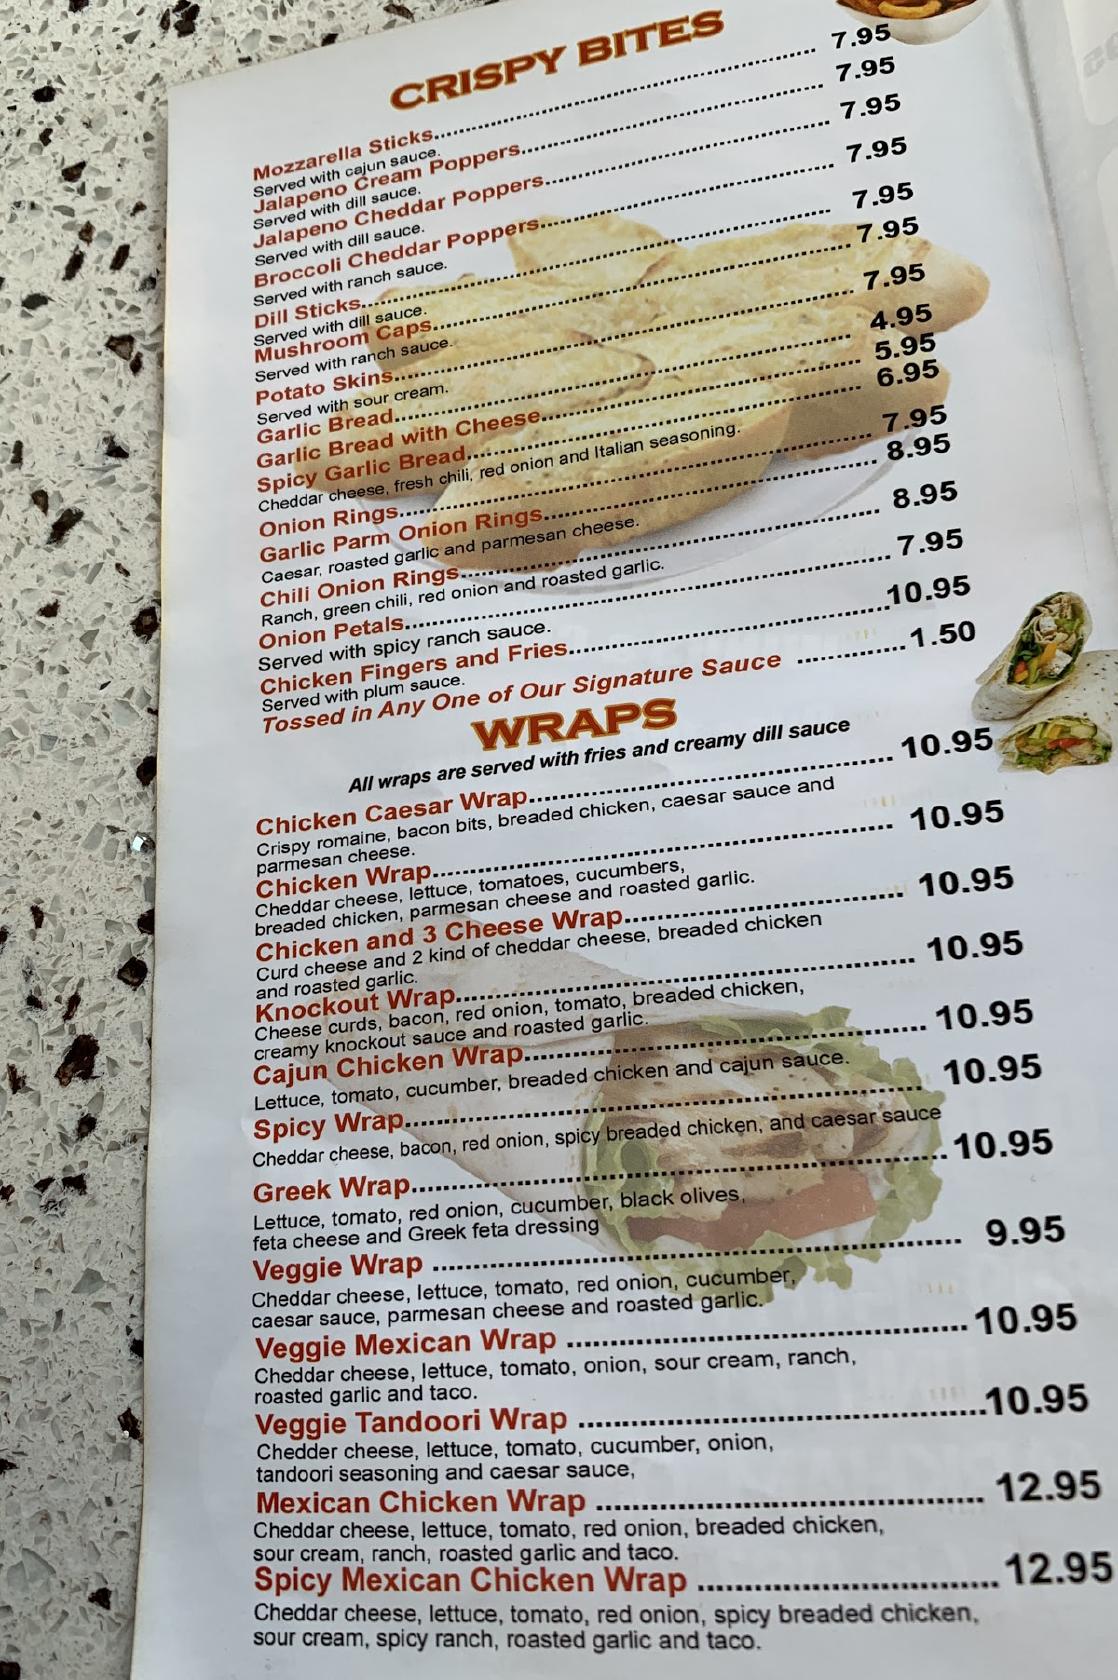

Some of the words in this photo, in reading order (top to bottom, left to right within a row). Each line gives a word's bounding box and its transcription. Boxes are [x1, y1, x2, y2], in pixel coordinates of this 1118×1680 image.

[391, 47, 565, 110] CRISPY
[578, 10, 724, 66] BITES
[252, 184, 348, 214] Jalapeno
[354, 167, 422, 192] Cream
[429, 144, 520, 175] Poppers
[835, 55, 896, 83] 7.95
[253, 146, 362, 180] Mozzarella
[368, 130, 433, 153] Sticks
[830, 22, 892, 50] 7.95
[253, 175, 306, 198] Served
[309, 168, 341, 185] with
[345, 160, 386, 178] cajun
[390, 148, 442, 168] sauce.
[254, 257, 341, 289] Broccoli
[347, 240, 440, 269] Cheddar
[446, 219, 540, 249] Poppers
[845, 135, 908, 164] 7.95
[253, 285, 307, 307] Served
[311, 279, 343, 296] with
[347, 269, 392, 289] ranch
[396, 261, 448, 279] sauce.
[254, 308, 288, 330] Dill
[294, 299, 362, 321] Sticks
[851, 181, 914, 210] 7.95
[255, 383, 326, 406] Potato
[333, 371, 394, 392] Skins
[862, 262, 926, 291] 7.95
[256, 424, 321, 445] Garlic
[328, 407, 394, 433] Bread
[869, 303, 933, 331] 4.95
[256, 404, 312, 426] Served
[316, 398, 349, 415] with
[353, 393, 390, 409] sour
[393, 384, 449, 402] cream.
[257, 471, 318, 495] Spicy
[324, 460, 390, 482] Garlic
[399, 444, 466, 471] Bread
[876, 358, 940, 387] 6.95
[258, 493, 324, 513] Cheddar
[328, 484, 389, 502] cheese,
[393, 475, 434, 493] fresh
[438, 467, 473, 485] chili,
[479, 461, 505, 480] red
[510, 456, 554, 474] onion
[559, 447, 590, 466] and
[594, 440, 644, 459] Italian
[649, 424, 741, 449] seasoning.
[259, 517, 326, 538] Onion
[333, 506, 399, 528] Rings
[881, 404, 948, 433] 7.95
[258, 629, 326, 650] Onion
[334, 618, 404, 640] Petals
[896, 527, 964, 557] 7.95
[258, 648, 323, 672] Served
[328, 643, 367, 662] with
[373, 638, 421, 659] spicy
[427, 628, 481, 648] ranch
[486, 622, 552, 641] sauce.
[260, 671, 353, 696] Chicken
[360, 658, 448, 681] Fingers
[455, 647, 499, 669] and
[508, 642, 568, 662] Fries
[886, 574, 971, 605] 10.95
[264, 708, 346, 734] Tossed
[351, 707, 373, 722] in
[378, 700, 424, 719] Any
[431, 692, 481, 711] One
[487, 684, 513, 704] of
[519, 682, 565, 700] Our
[572, 666, 694, 696] Signature
[701, 655, 782, 677] Sauce
[910, 620, 976, 648] 1.50
[347, 775, 375, 794] All
[377, 770, 432, 790] wraps
[436, 766, 467, 781] are
[470, 754, 536, 778] served
[539, 750, 580, 769] with
[583, 746, 627, 764] fries
[631, 738, 670, 758] and
[673, 732, 747, 753] creamy
[752, 723, 784, 744] dill
[788, 719, 851, 739] sauce
[471, 698, 677, 752] WRAPS
[255, 811, 357, 836] Chicken
[365, 799, 453, 822] Caesar
[459, 790, 528, 811] Wrap
[900, 726, 994, 759] 10.95
[256, 854, 343, 878] parmesan
[347, 845, 416, 864] cheese.
[255, 938, 359, 962] Chicken
[366, 927, 414, 951] and
[423, 924, 437, 944] 3
[445, 917, 544, 942] Cheese
[551, 909, 623, 930] Wrap
[918, 865, 1015, 897] 10.95
[255, 982, 289, 1000] and
[294, 975, 360, 997] roasted
[365, 969, 418, 993] garlic.
[252, 1063, 328, 1089] Cajun
[336, 1052, 444, 1079] Chicken
[451, 1045, 524, 1068] Wrap
[935, 998, 1034, 1031] 10.95
[254, 1093, 325, 1112] Lettuce,
[331, 1085, 400, 1105] tomato,
[405, 1076, 501, 1098] cucumber,
[508, 1067, 588, 1090] breaded
[593, 1063, 669, 1085] chicken
[675, 1057, 713, 1077] and
[719, 1055, 775, 1077] cajun
[781, 1050, 850, 1069] sauce.
[253, 1180, 330, 1204] Greek
[338, 1175, 411, 1200] Wrap
[953, 1127, 1054, 1160] 10.95
[252, 1235, 288, 1252] feta
[292, 1232, 361, 1250] cheese
[365, 1226, 402, 1245] and
[408, 1223, 468, 1242] Greek
[471, 1221, 509, 1239] feta
[514, 1216, 600, 1237] dressing
[255, 1336, 347, 1364] Veggie
[355, 1333, 471, 1357] Mexican
[479, 1327, 557, 1355] Wrap
[974, 1302, 1078, 1335] 10.95
[254, 1387, 323, 1405] roasted
[329, 1385, 382, 1408] garlic
[387, 1384, 423, 1403] and
[429, 1384, 478, 1401] taco.
[256, 1491, 370, 1514] Mexican
[379, 1489, 498, 1514] Chicken
[506, 1488, 586, 1518] Wrap
[995, 1469, 1102, 1503] 12.95
[252, 1548, 295, 1562] sour
[299, 1548, 364, 1565] cream,
[372, 1543, 431, 1565] ranch,
[439, 1543, 513, 1563] roasted
[519, 1542, 577, 1566] garlic
[581, 1542, 621, 1562] and
[626, 1543, 679, 1561] taco.
[255, 1565, 332, 1597] Spicy
[342, 1566, 461, 1593] Mexican
[470, 1566, 595, 1593] Chicken
[604, 1565, 688, 1598] Wrap
[1005, 1550, 1114, 1586] 12.95
[253, 1631, 297, 1647] sour
[302, 1631, 370, 1650] cream,
[376, 1628, 429, 1653] spicy
[435, 1628, 499, 1651] ranch,
[507, 1629, 586, 1649] roasted
[592, 1630, 652, 1655] garlic
[659, 1630, 700, 1650] and
[705, 1631, 761, 1651] taco.
